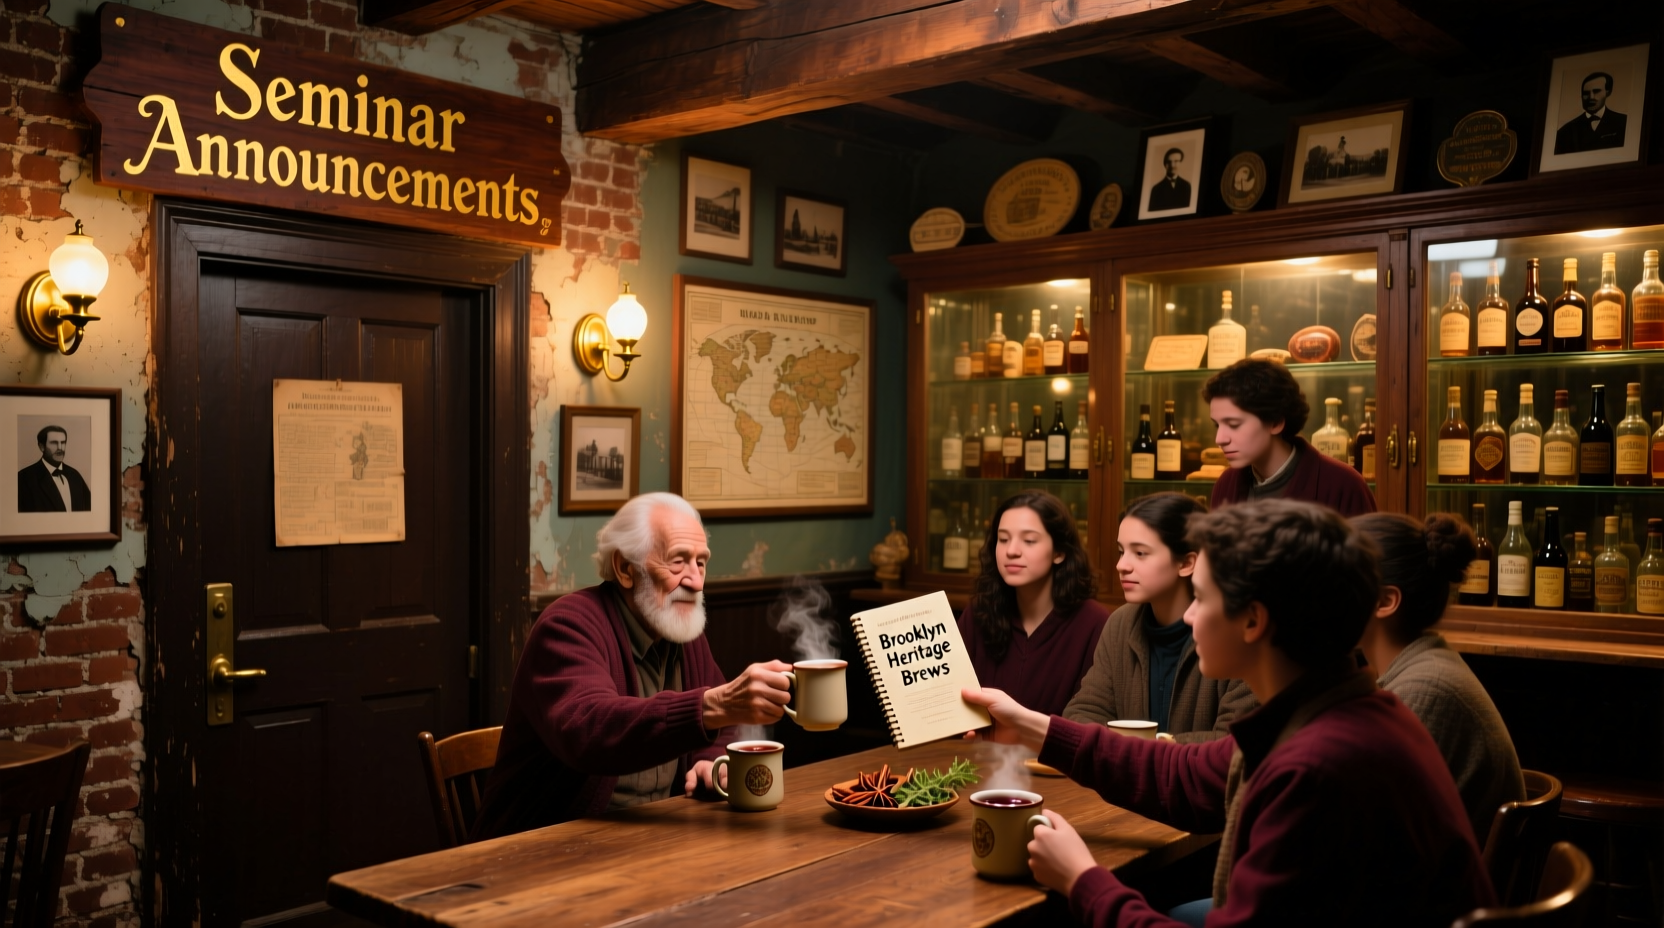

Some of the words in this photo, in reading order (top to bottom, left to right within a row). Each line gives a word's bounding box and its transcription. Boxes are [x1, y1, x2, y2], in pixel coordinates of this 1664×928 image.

[215, 42, 465, 153] Seminar
[123, 94, 539, 226] Announcements
[879, 622, 946, 650] Brooklyn
[887, 640, 951, 668] Heritage
[901, 662, 950, 687] Brews
